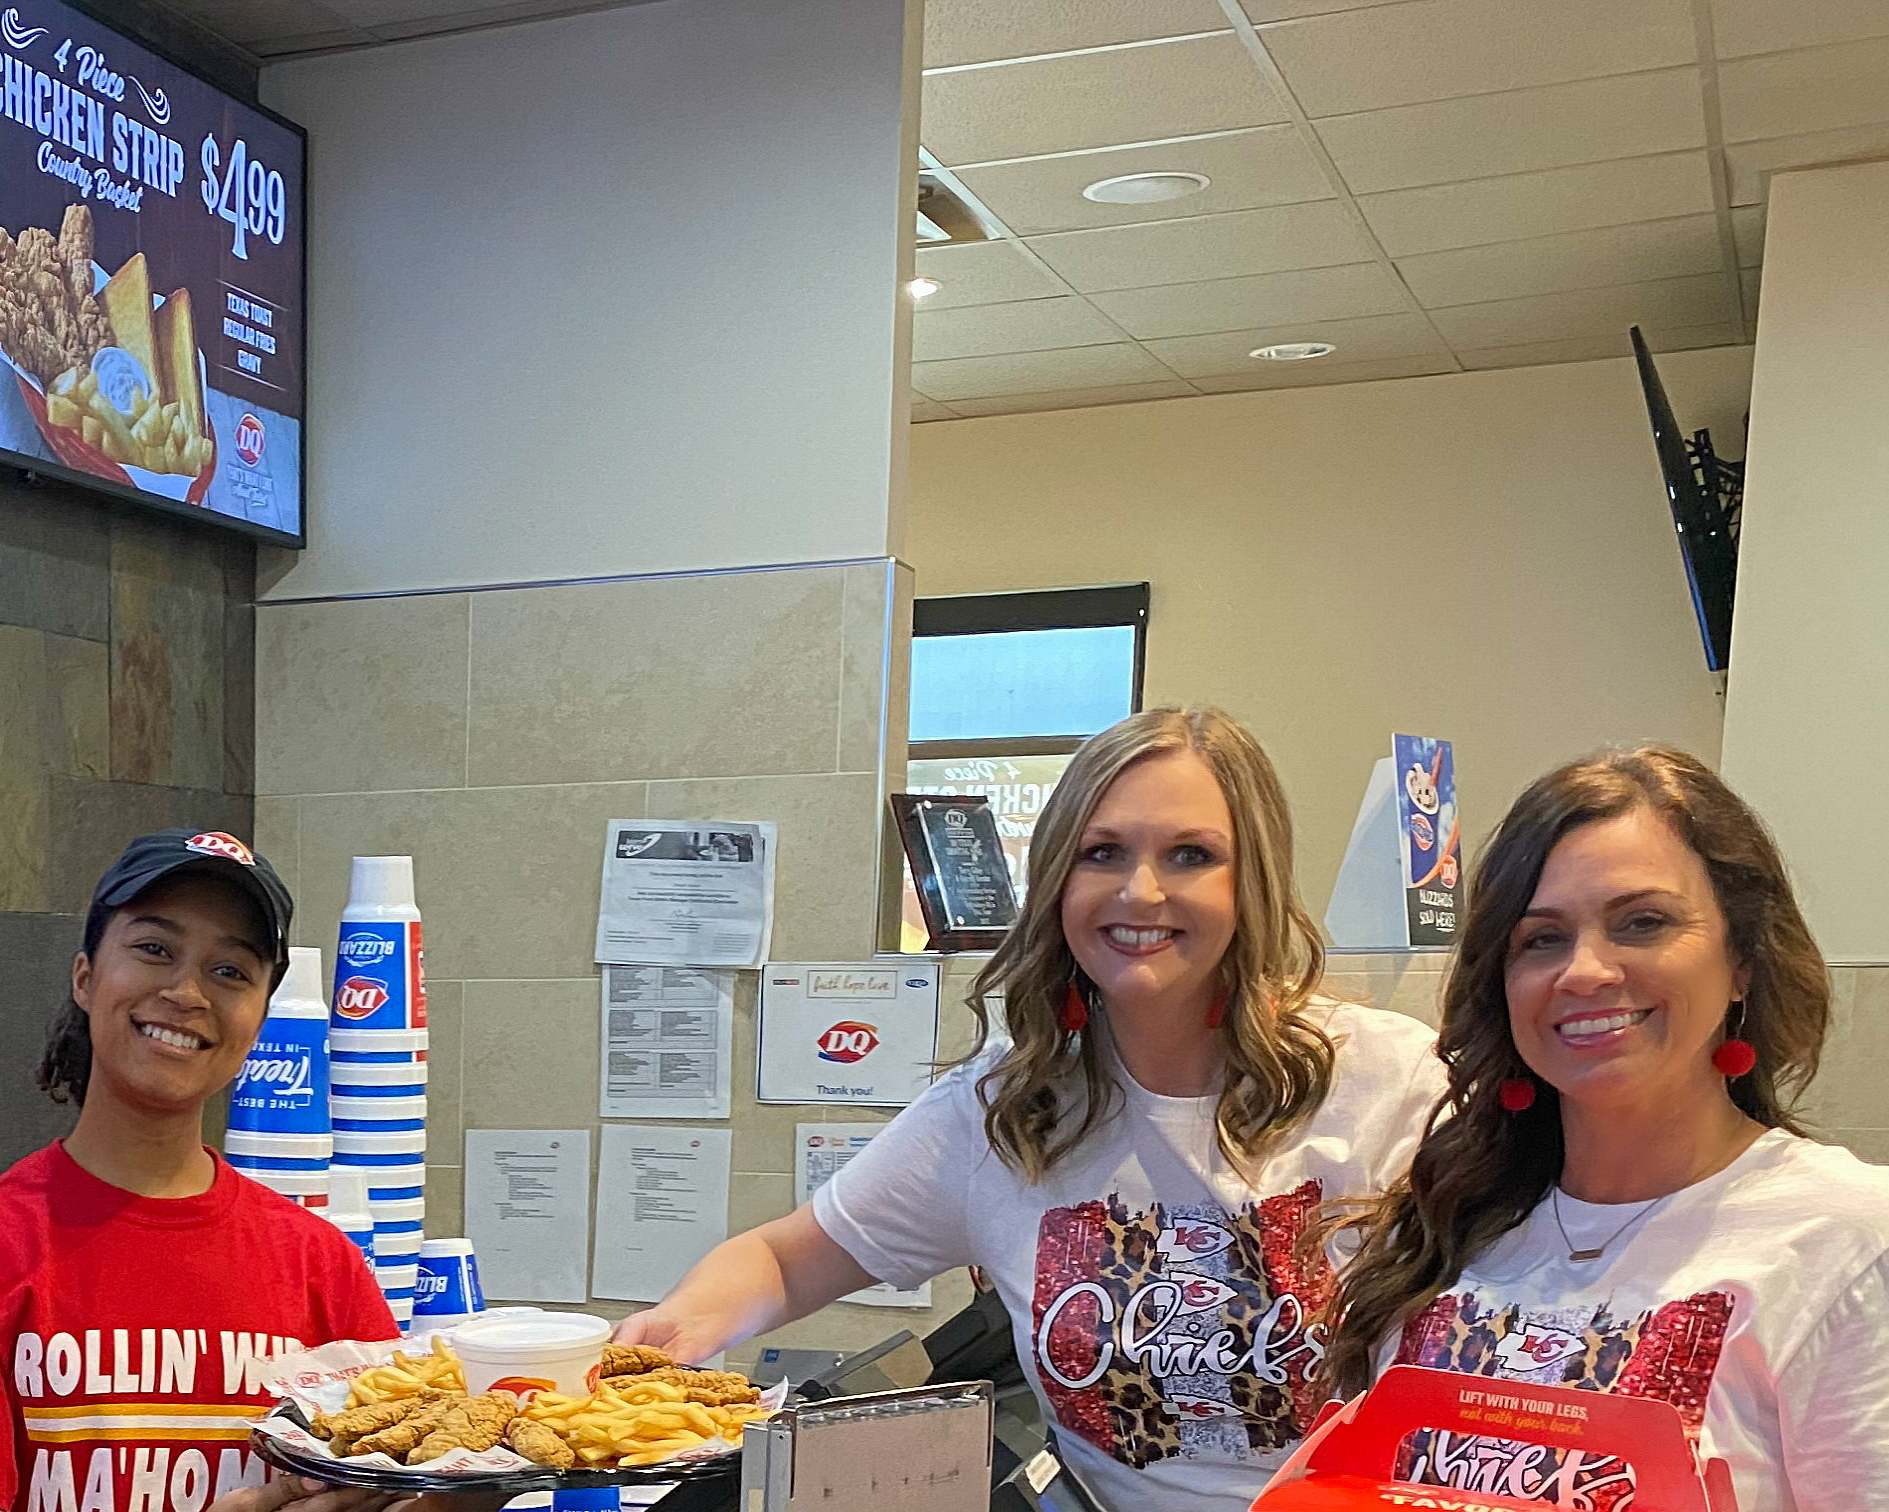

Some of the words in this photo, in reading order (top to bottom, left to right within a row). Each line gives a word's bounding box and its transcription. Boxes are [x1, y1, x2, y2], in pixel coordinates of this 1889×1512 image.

[54, 38, 72, 73] 4
[75, 45, 127, 103] Piece
[109, 111, 184, 198] STRIP
[37, 140, 94, 200] Country
[95, 169, 144, 214] Basket
[226, 292, 249, 321] TEXAS
[249, 301, 274, 328] TOAST
[340, 985, 378, 1009] DQ
[825, 1030, 872, 1056] DQ
[237, 1097, 265, 1109] BEST
[270, 1098, 297, 1110] THE
[816, 1085, 848, 1096] Thank
[850, 1086, 874, 1098] you!
[1176, 1224, 1222, 1254] KC
[14, 1328, 208, 1398] ROLLIN'
[1523, 1330, 1569, 1363] KC
[1459, 1389, 1483, 1405] LIFT
[1485, 1392, 1520, 1411] WITH
[1522, 1398, 1555, 1416] YOUR
[1556, 1402, 1589, 1422] LEGS,
